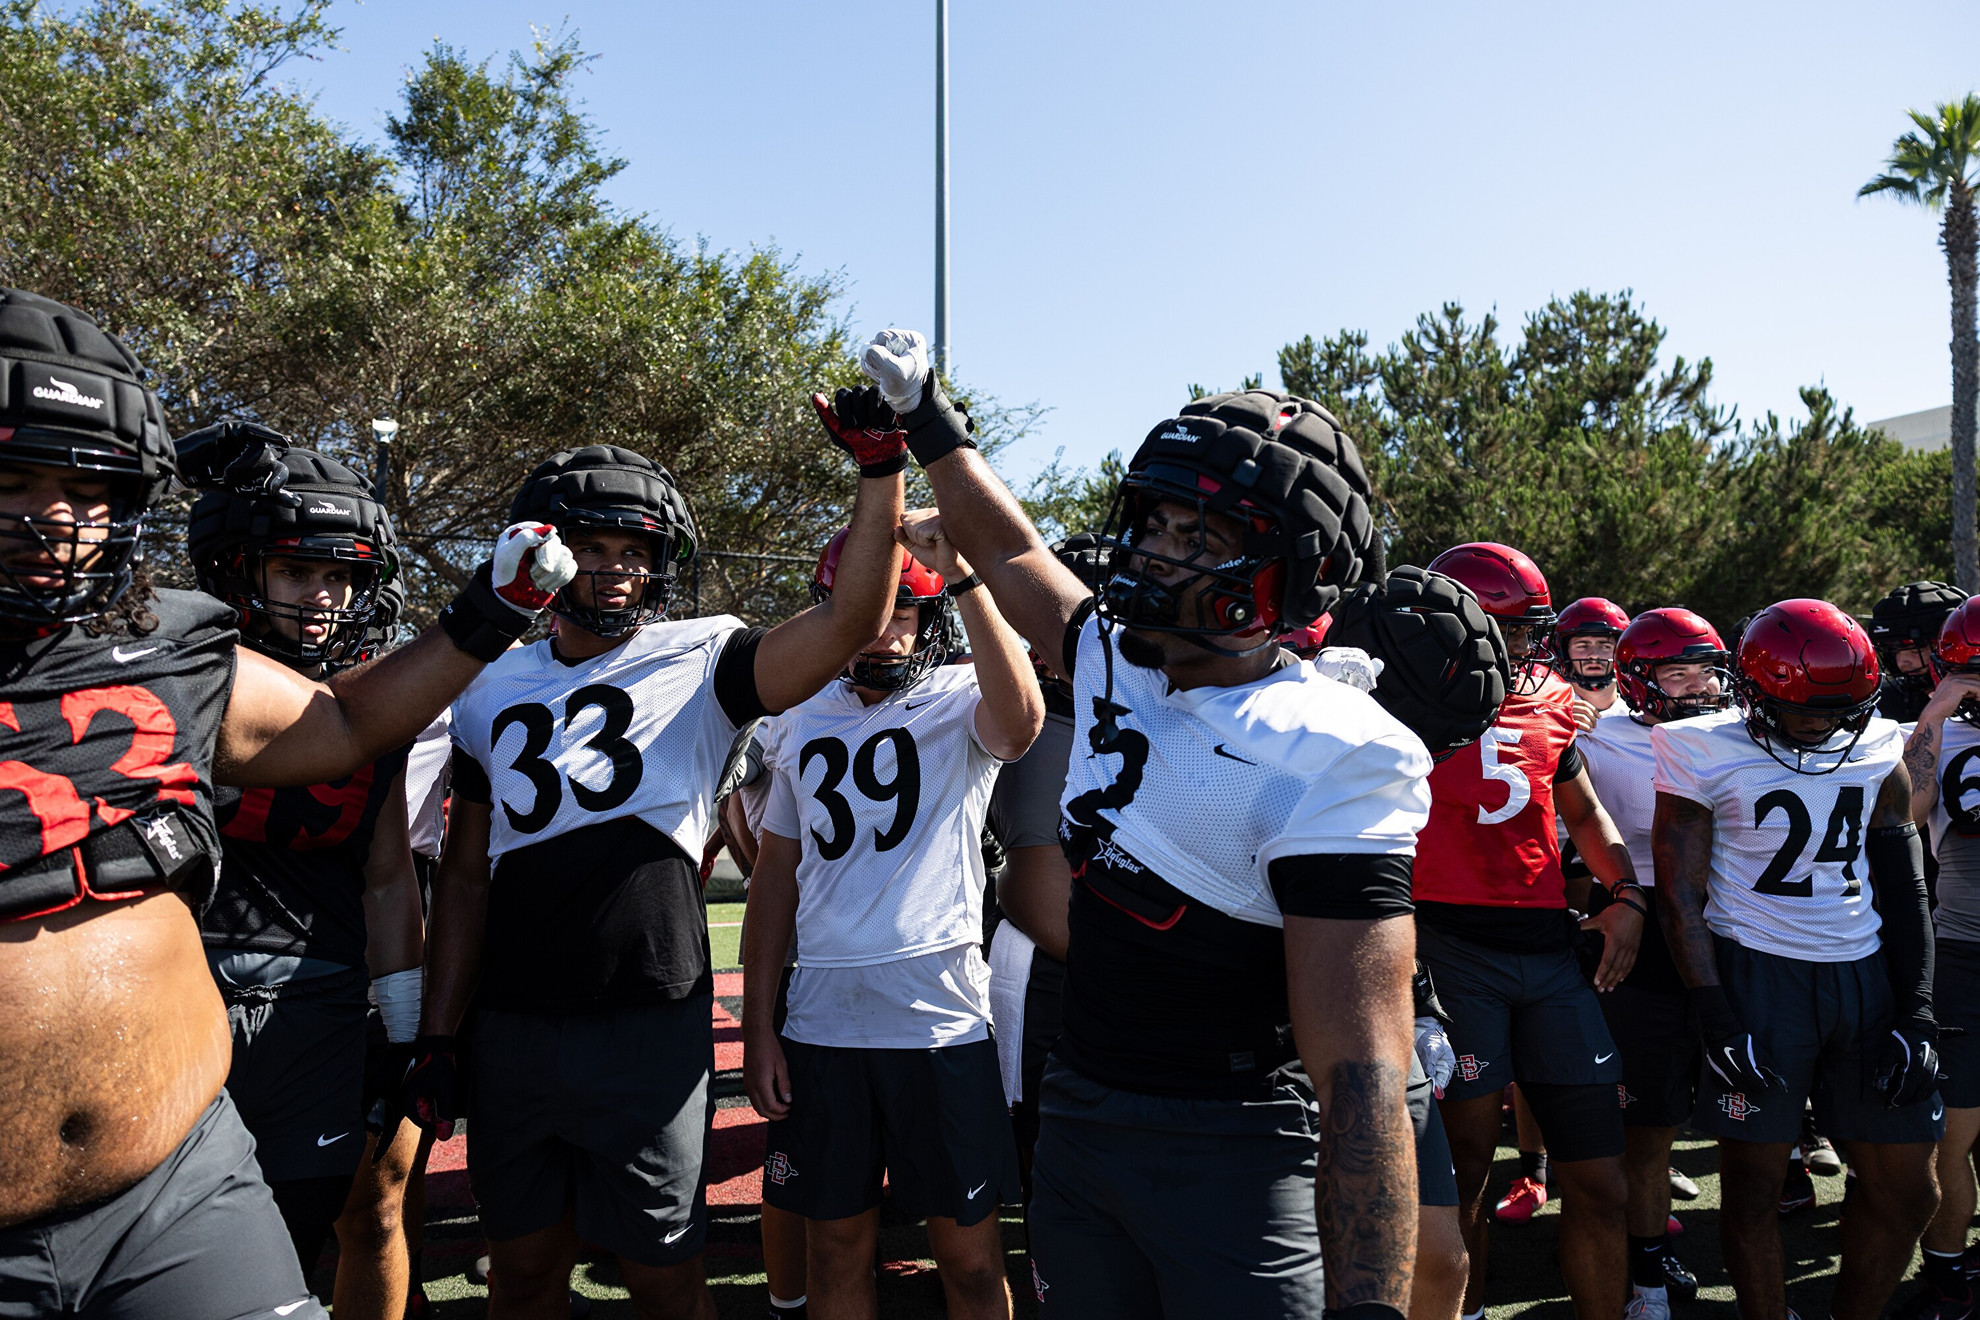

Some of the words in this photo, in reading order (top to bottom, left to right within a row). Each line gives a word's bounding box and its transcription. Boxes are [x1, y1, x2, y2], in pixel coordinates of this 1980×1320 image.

[1160, 432, 1198, 443] GUARDIAN
[309, 507, 350, 516] GUARDIAN
[491, 683, 643, 834] 33
[799, 726, 920, 861] 39
[1477, 726, 1531, 825] 5
[1104, 846, 1140, 874] Douglas
[1750, 786, 1864, 898] 24
